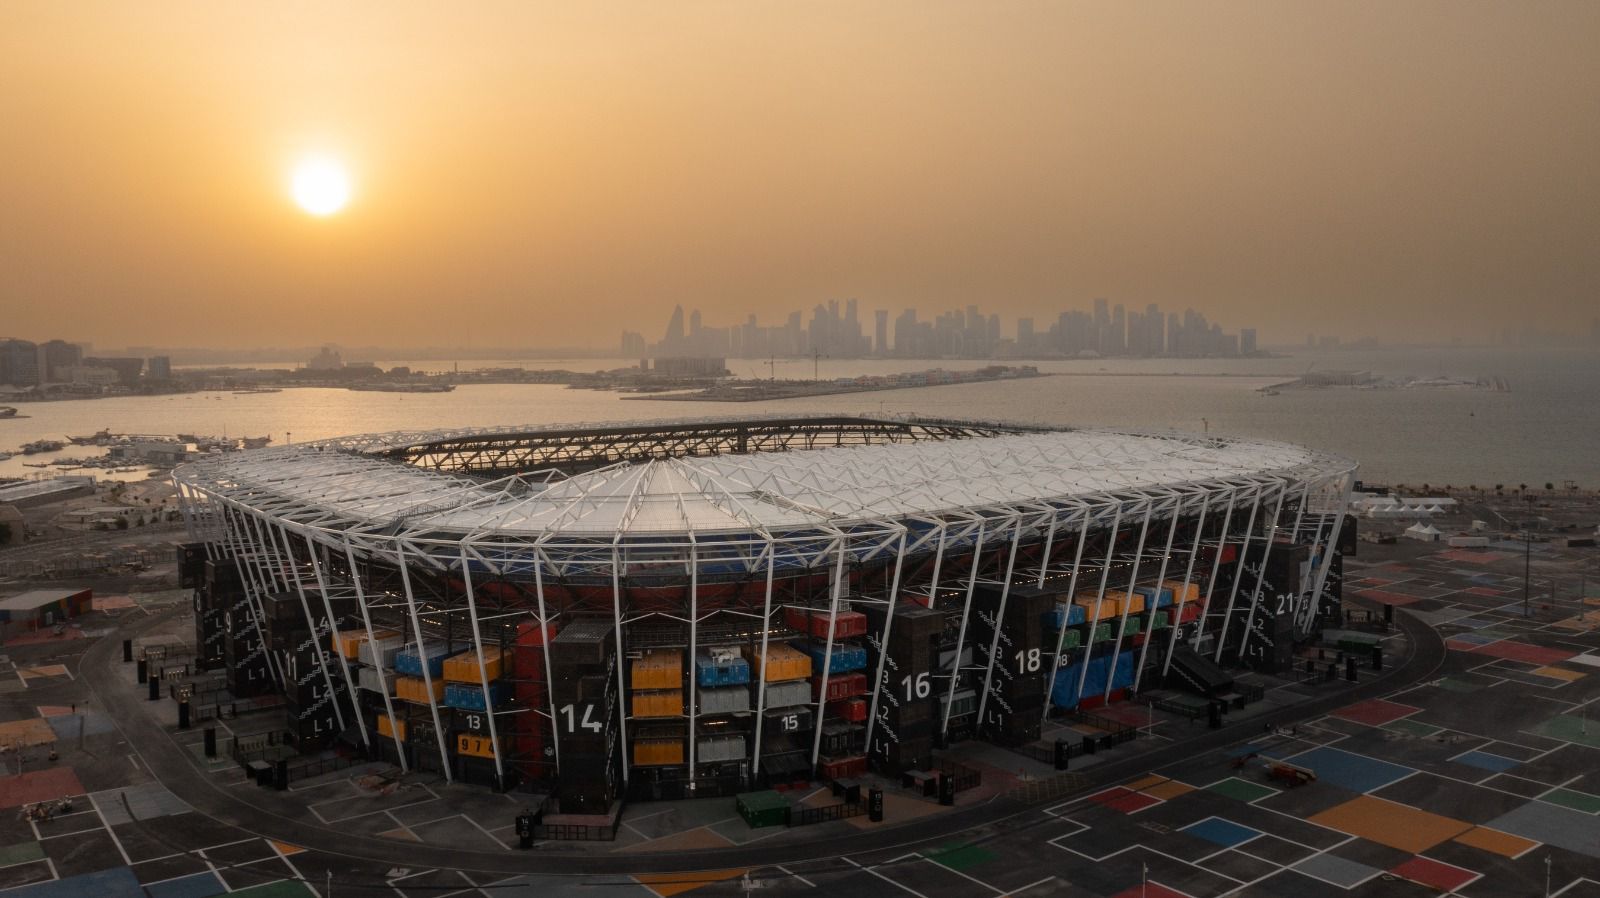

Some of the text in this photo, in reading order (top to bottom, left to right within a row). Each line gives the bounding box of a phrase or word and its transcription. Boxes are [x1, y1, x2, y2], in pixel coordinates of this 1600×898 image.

[1276, 592, 1293, 615] 21
[225, 611, 231, 633] 9
[1250, 644, 1264, 658] L1
[1015, 648, 1041, 675] 18
[249, 667, 265, 680] L1
[901, 672, 931, 702] 16
[314, 717, 334, 733] L1
[466, 714, 481, 730] 13
[560, 703, 603, 733] 14
[781, 714, 799, 730] 15
